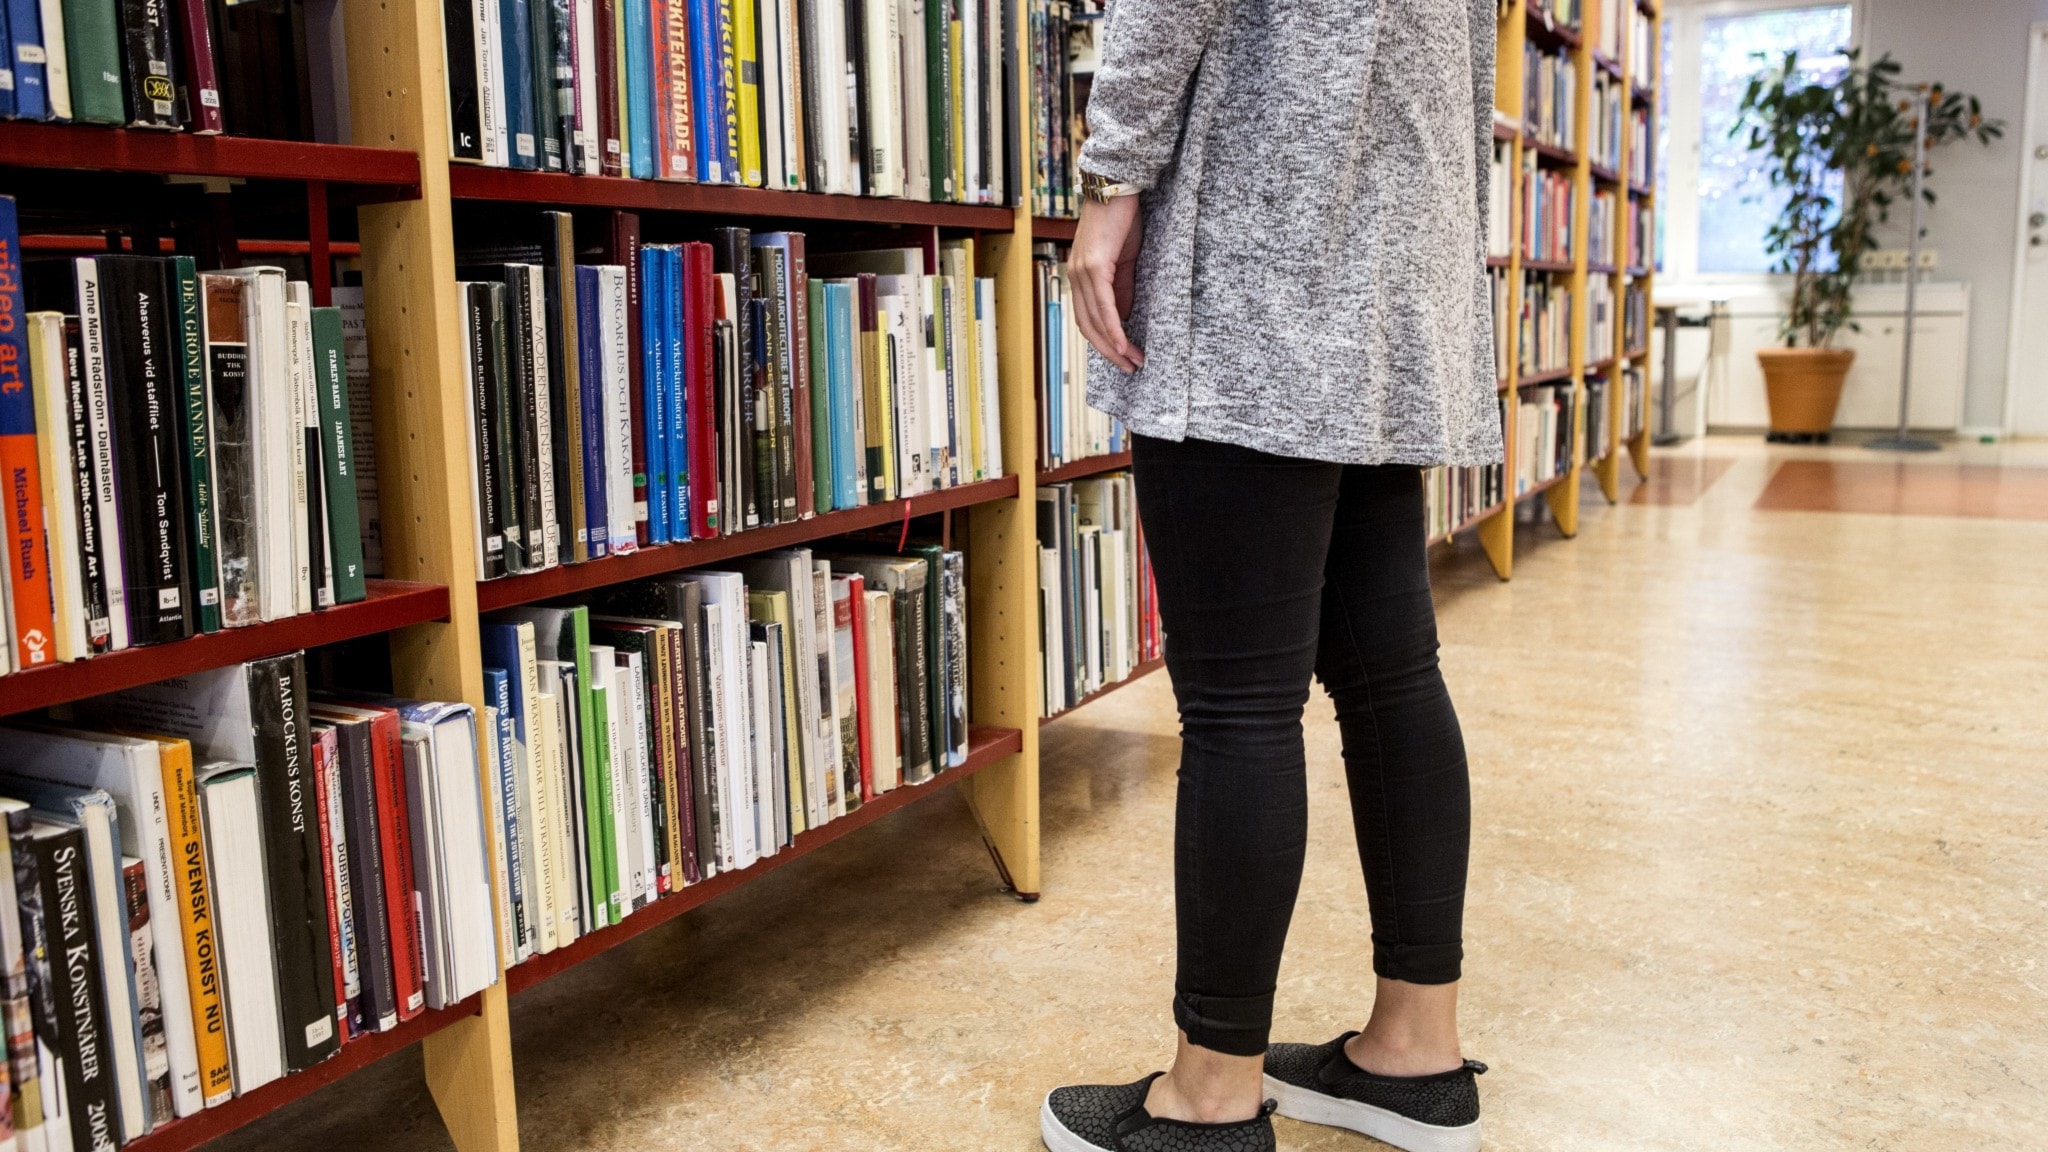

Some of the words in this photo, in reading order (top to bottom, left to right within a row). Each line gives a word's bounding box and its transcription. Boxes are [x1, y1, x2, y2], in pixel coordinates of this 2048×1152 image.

[480, 28, 488, 45] Jan
[482, 49, 490, 83] Torsten
[483, 86, 493, 131] Ahlstrand
[774, 253, 785, 297] MODERN
[795, 257, 804, 283] De
[85, 280, 95, 310] Anne
[182, 279, 196, 314] DEN
[523, 276, 532, 332] CLASSICAL
[739, 262, 752, 346] SVENSKA
[796, 291, 806, 330] röda
[88, 320, 99, 353] Marie
[138, 292, 151, 355] Ahasverus
[474, 306, 484, 364] ANNA-MARIA
[613, 275, 626, 373] BORGARHUS
[765, 311, 773, 357] ALAIN
[778, 299, 789, 371] ARCHITECTURE
[1, 343, 25, 394] art
[69, 347, 78, 375] New
[145, 359, 155, 378] vid
[184, 320, 201, 379] GRÖNE
[798, 337, 808, 388] husen
[90, 356, 105, 420] Rådström
[477, 365, 488, 411] BLENNOW
[525, 337, 537, 417] ARCHITECTURE
[535, 326, 551, 457] MODERNISMENS
[618, 376, 628, 409] OCH
[655, 338, 665, 430] Arkitekturhistoria
[673, 338, 684, 430] Arkitekturhistoria
[781, 375, 789, 384] IN
[71, 381, 84, 421] Media
[146, 382, 160, 430] staffliet
[189, 384, 206, 458] MANNEN
[782, 387, 792, 426] EUROPE
[75, 424, 84, 436] in
[335, 421, 345, 459] JAPANESE
[481, 418, 491, 461] EUROPAS
[77, 440, 87, 469] Late
[97, 431, 112, 503] Dalahästen
[338, 461, 347, 476] ART
[14, 467, 31, 534] Michael
[79, 471, 95, 553] 20th-Century
[157, 492, 167, 517] Tom
[484, 463, 494, 525] TRÄDGÅRDAR
[540, 462, 557, 548] ARKITEKTUR
[660, 490, 669, 524] Textdel
[678, 486, 688, 521] Bilddel
[20, 538, 36, 580] Rush
[87, 556, 98, 577] Art
[158, 520, 174, 580] Sandqvist
[159, 614, 183, 623] Atlantis
[915, 592, 926, 678] Sommarnöjet
[660, 634, 668, 658] BENGT
[673, 629, 683, 672] THEATRE
[528, 659, 537, 692] FRÅN
[676, 673, 684, 694] AND
[498, 679, 509, 714] ICONS
[714, 674, 723, 722] Vardagens
[279, 676, 300, 777] BAROCKENS
[501, 718, 510, 733] OF
[665, 725, 673, 759] SVENSKA
[677, 696, 688, 749] PLAYHOUSE
[317, 760, 323, 770] De
[640, 746, 648, 784] FOLKETS
[717, 723, 727, 767] arkitektur
[317, 771, 325, 799] berömda
[502, 737, 517, 820] ARCHITECTURE
[604, 762, 612, 778] MED
[605, 780, 613, 795] NYA
[186, 780, 194, 804] Sophie
[289, 780, 305, 833] KONST
[537, 790, 546, 812] TILL
[642, 787, 650, 818] TJÄNST
[667, 760, 678, 832] BYGGNADSKONSTENS
[180, 803, 189, 837] Malmborg
[321, 813, 328, 822] de
[321, 823, 330, 846] glömda
[509, 823, 517, 840] THE
[630, 799, 639, 835] Theory
[158, 837, 171, 901] PRESENTATIONER
[398, 842, 408, 896] MODERNISM
[511, 841, 519, 860] 20TH
[539, 817, 553, 912] STRANDBODAR
[672, 834, 681, 866] MAGASIN
[53, 846, 81, 940] SVENSKA
[185, 841, 207, 924] SVENSK
[500, 870, 510, 918] Architecture
[513, 862, 523, 896] CENTURY
[336, 842, 358, 974] DUBBELPORTRÄTT
[136, 937, 149, 978] västerås
[196, 929, 217, 997] KONST
[66, 941, 99, 1083] KONSTNÄRER
[142, 979, 152, 1008] konst
[205, 1005, 221, 1034] NU
[87, 1100, 110, 1151] 2008
